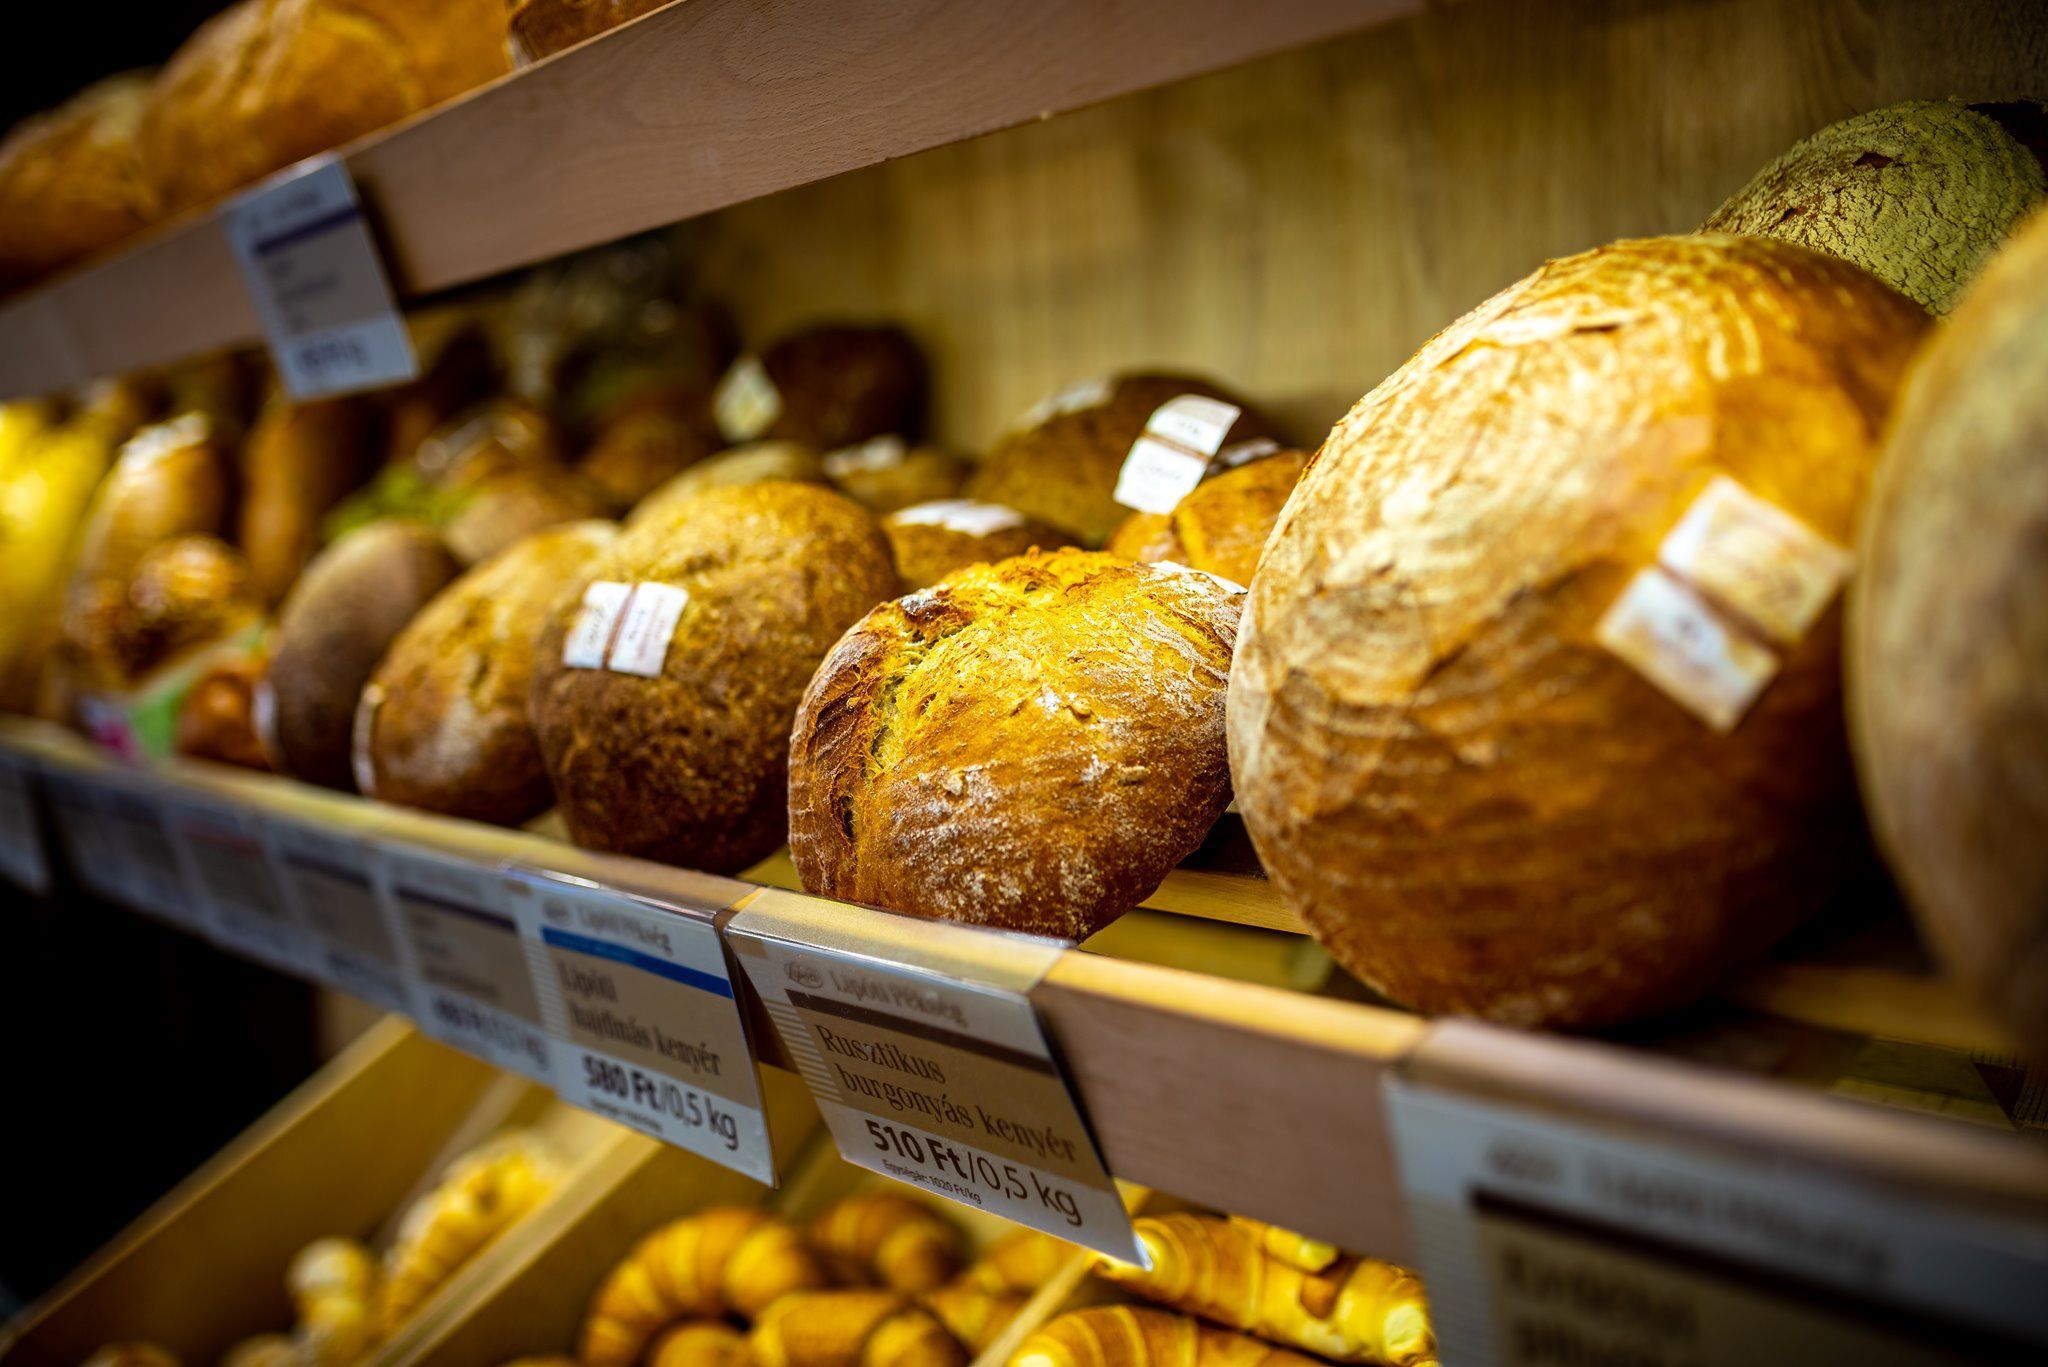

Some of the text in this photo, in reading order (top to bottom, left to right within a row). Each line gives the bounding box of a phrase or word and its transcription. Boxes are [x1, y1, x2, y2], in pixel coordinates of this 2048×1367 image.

[815, 1024, 947, 1085] Rusztikus
[704, 1095, 740, 1151] kg
[835, 1062, 1077, 1163] burgonyás kenyér
[865, 1119, 1083, 1227] 510 Ft/0,5 kg
[929, 1174, 954, 1194] 1020
[953, 1183, 983, 1205] Ft/kg
